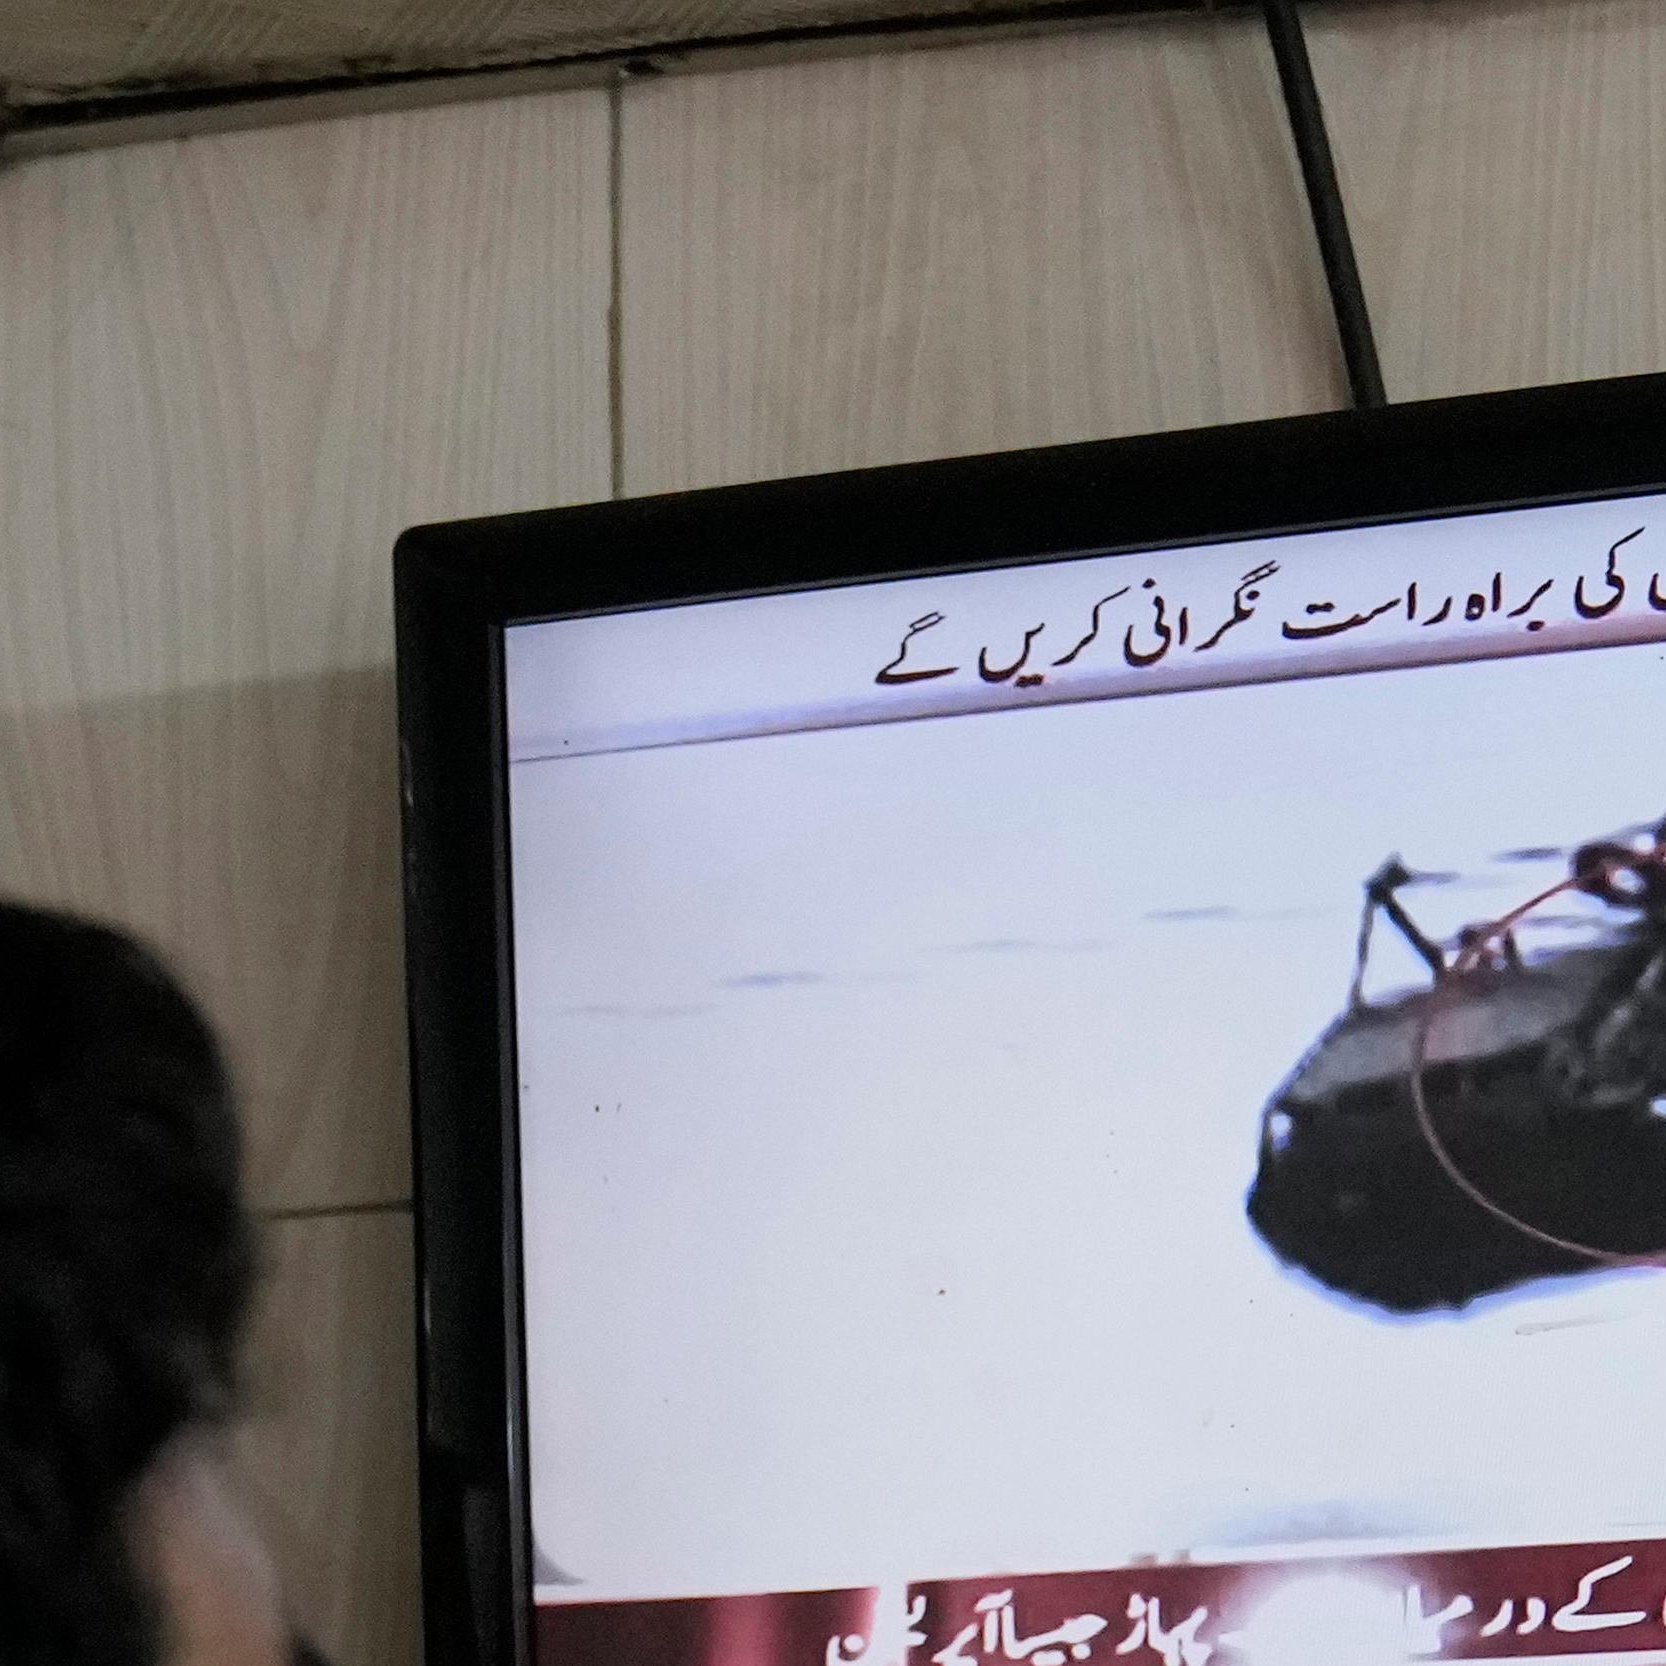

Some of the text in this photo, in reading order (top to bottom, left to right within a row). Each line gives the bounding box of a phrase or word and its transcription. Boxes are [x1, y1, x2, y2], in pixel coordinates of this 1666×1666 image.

[1123, 560, 1281, 668] نگرانی
[1573, 526, 1646, 620] کی
[874, 611, 959, 686] گے
[978, 586, 1131, 689] کریں
[1551, 1556, 1648, 1632] کے
